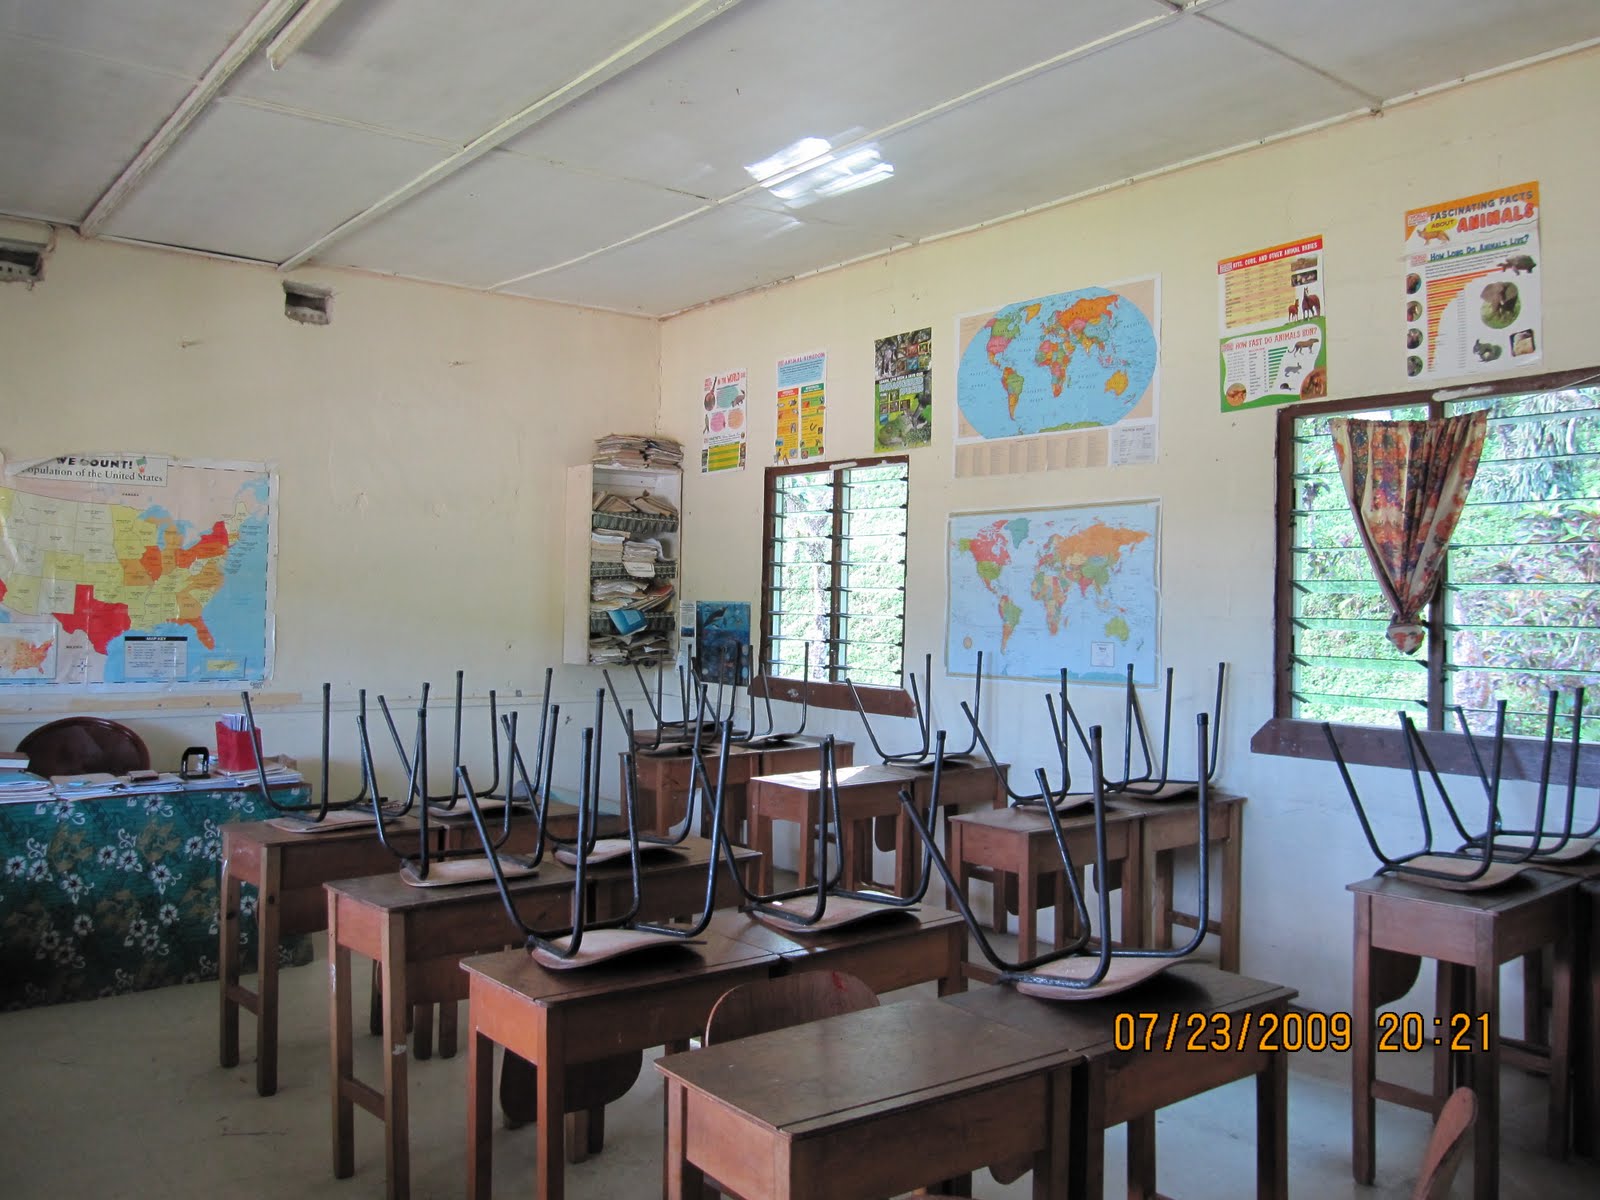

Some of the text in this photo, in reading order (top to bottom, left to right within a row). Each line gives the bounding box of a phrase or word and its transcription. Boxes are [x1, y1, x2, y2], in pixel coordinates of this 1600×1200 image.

[1430, 199, 1495, 220] FASCINATING
[1500, 191, 1533, 205] FACTS
[1431, 219, 1454, 228] ABOUT
[1457, 202, 1534, 233] ANIMALS
[1249, 338, 1262, 347] FAST
[1264, 336, 1273, 344] DO
[1274, 331, 1300, 342] ANIMALS
[56, 456, 133, 469] WE COUNT!
[76, 467, 86, 477] of
[88, 468, 103, 478] the
[105, 470, 135, 481] United
[137, 472, 163, 482] States
